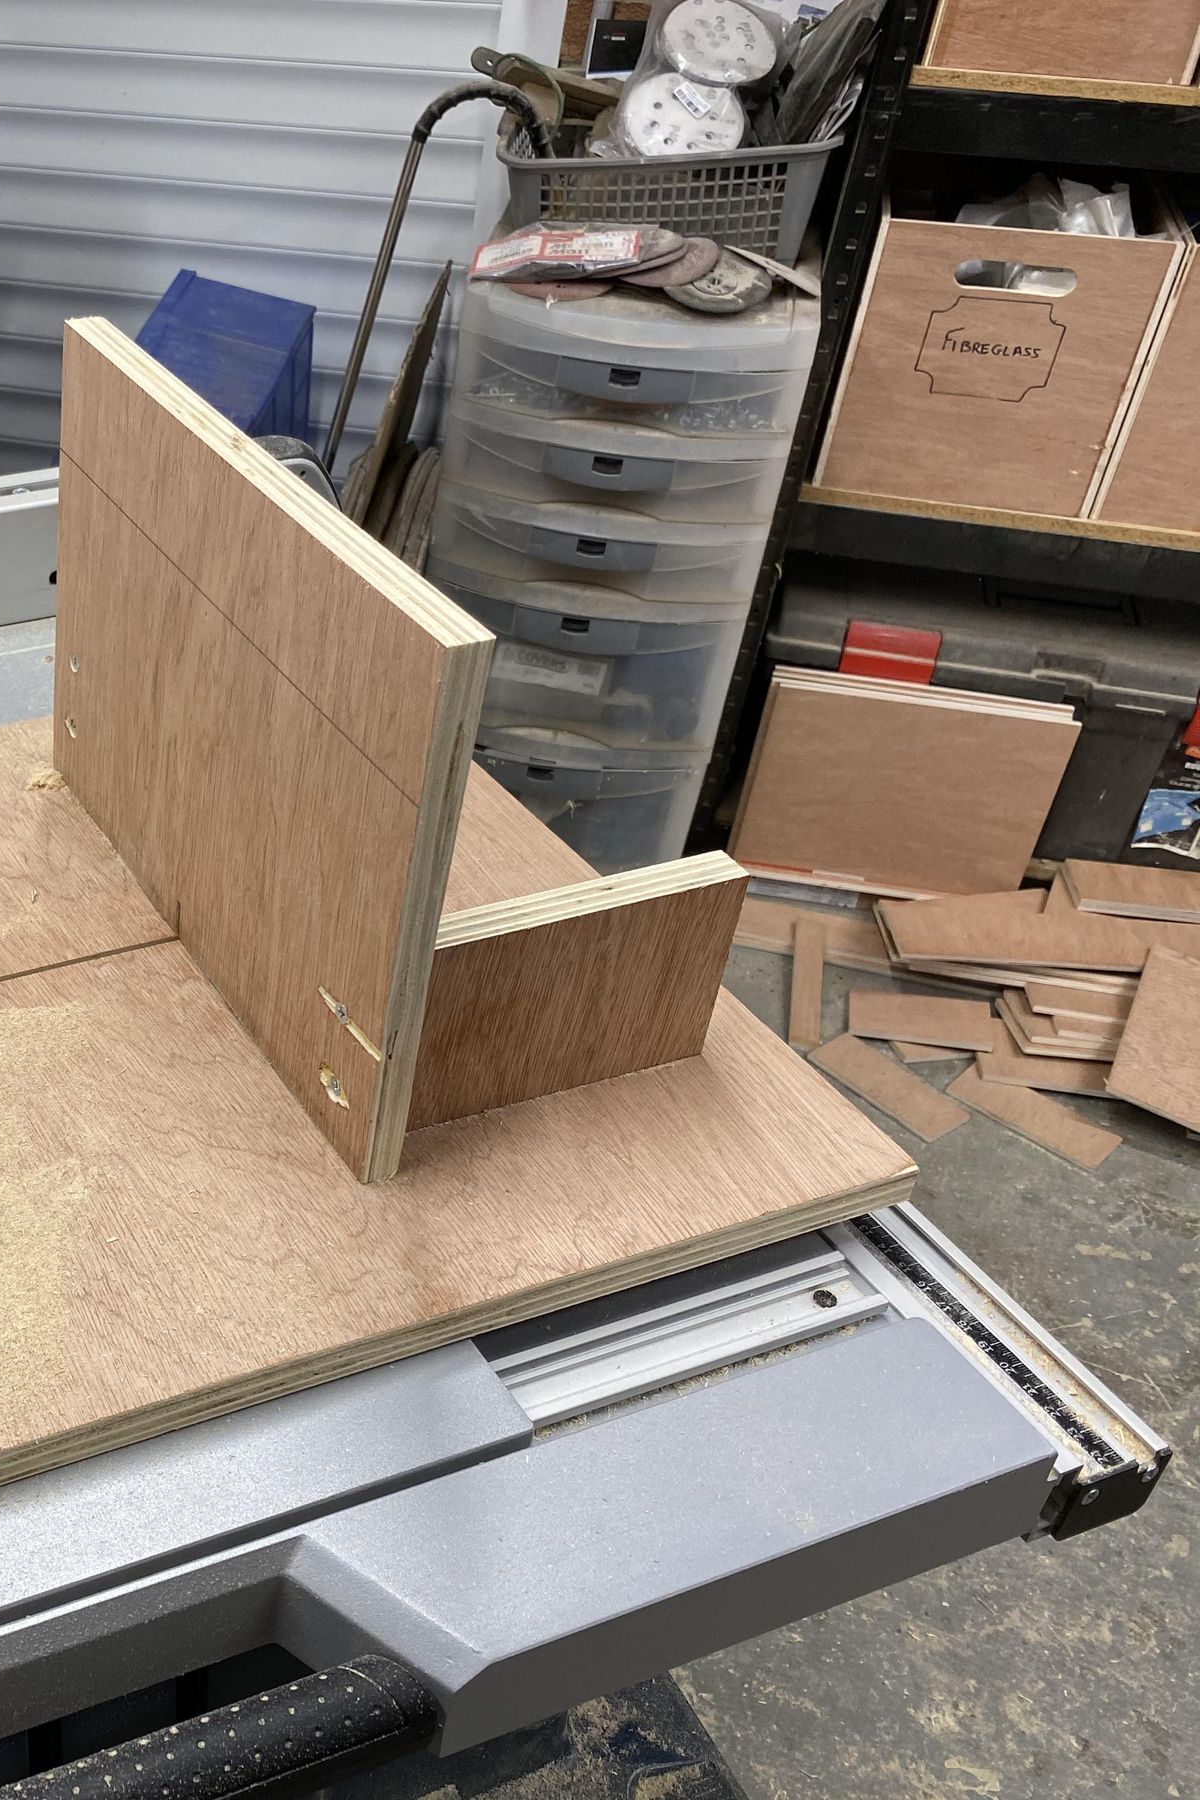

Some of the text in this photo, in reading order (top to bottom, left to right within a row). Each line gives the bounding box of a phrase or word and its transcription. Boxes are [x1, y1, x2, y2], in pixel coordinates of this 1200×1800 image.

[942, 327, 1042, 358] FIBREGLASS
[917, 1280, 932, 1292] 16
[936, 1301, 952, 1312] 17
[957, 1320, 973, 1332] 18
[978, 1340, 994, 1353] 19
[1000, 1361, 1018, 1375] 20
[1022, 1382, 1039, 1396] 21
[1044, 1405, 1062, 1420] 22
[1067, 1427, 1085, 1441] 23
